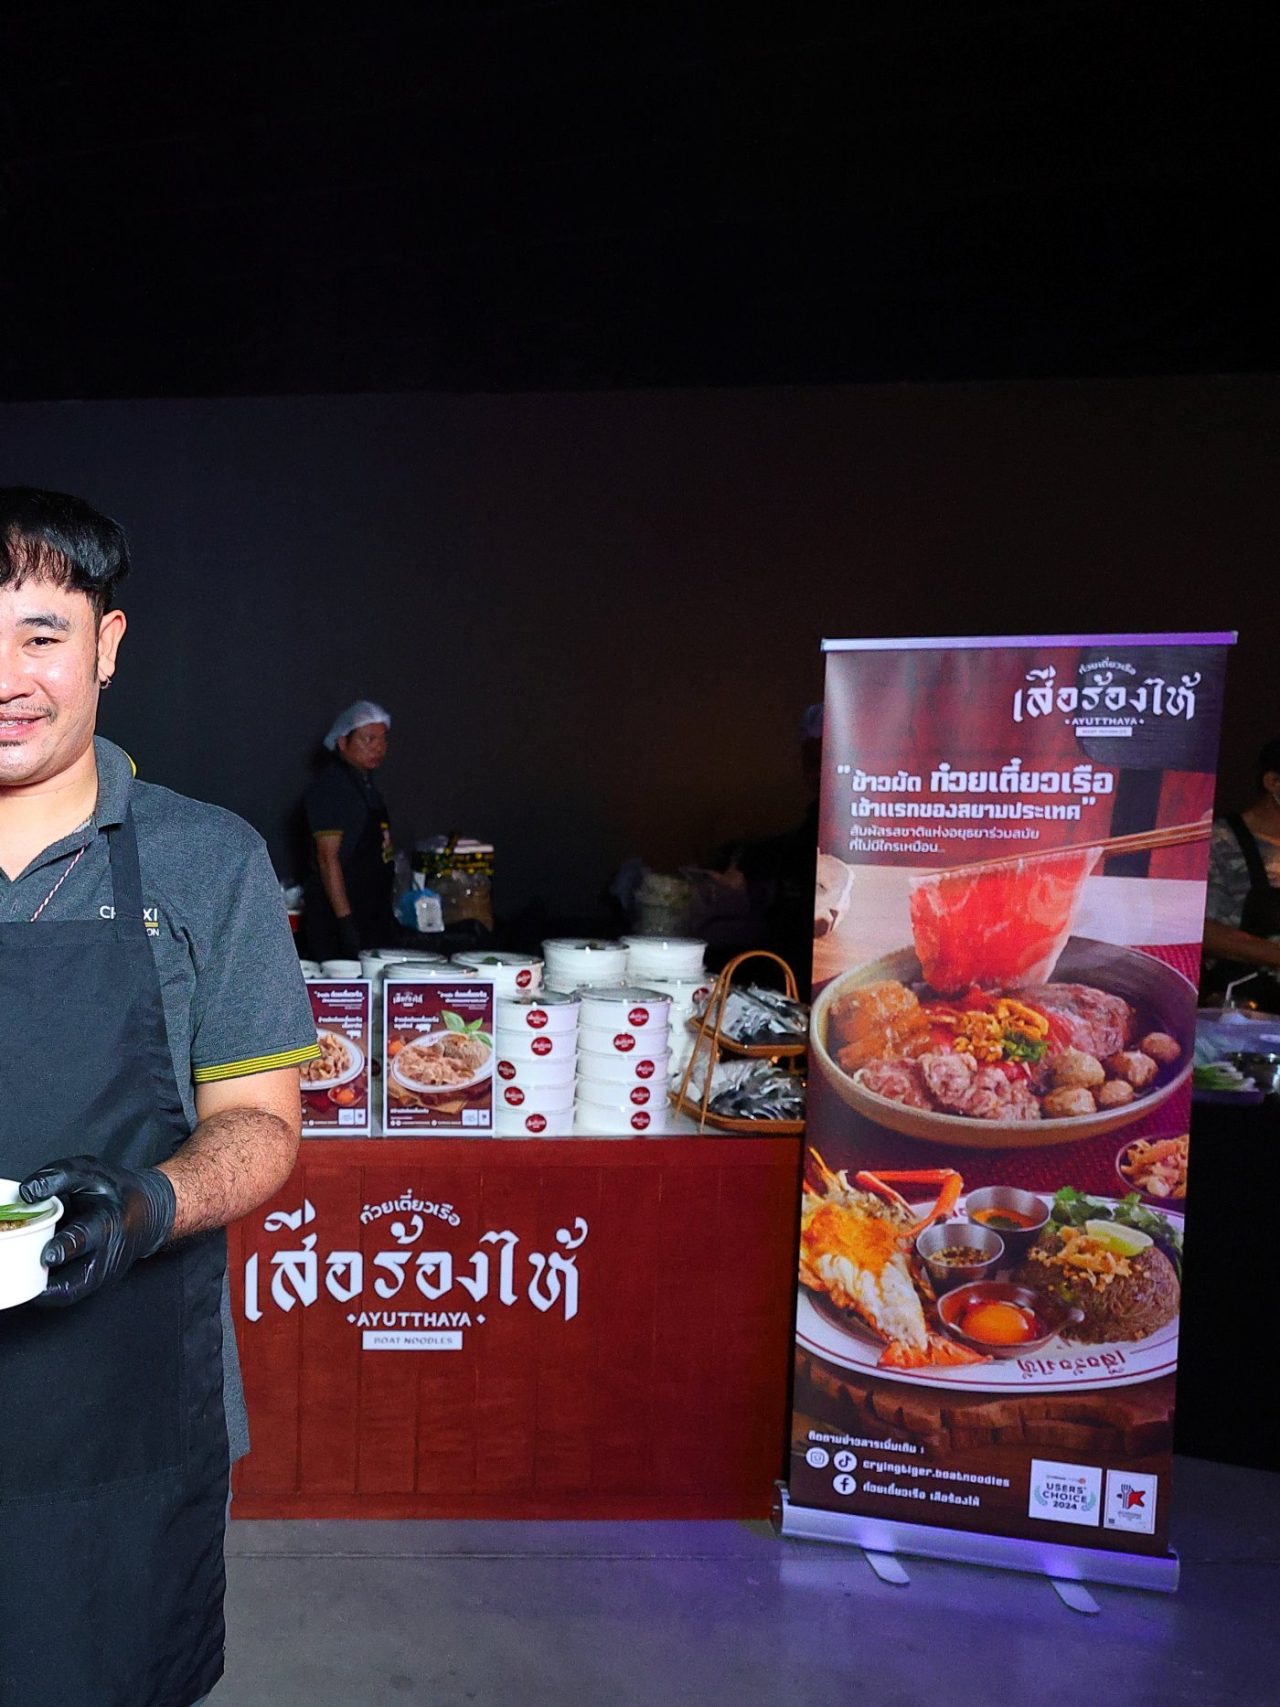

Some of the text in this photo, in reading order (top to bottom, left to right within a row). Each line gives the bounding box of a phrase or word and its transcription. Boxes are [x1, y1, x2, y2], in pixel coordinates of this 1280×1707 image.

[1012, 665, 1202, 722] เสือร้องไห้
[1072, 717, 1138, 726] AYUTTHAYA
[930, 757, 1114, 794] ก๋วยเตี๋ยวเรือ
[360, 1188, 461, 1227] ก๋วยเตี๋ยวเรือ
[244, 1199, 588, 1322] เสือร้องไห้
[357, 1311, 472, 1327] AYUTTHAYA
[373, 1336, 453, 1345] BOAT NOODLES
[862, 1459, 1010, 1488] cryingtiger.boatnoodles
[1042, 1491, 1087, 1503] CHOICE
[1052, 1501, 1078, 1510] 2024
